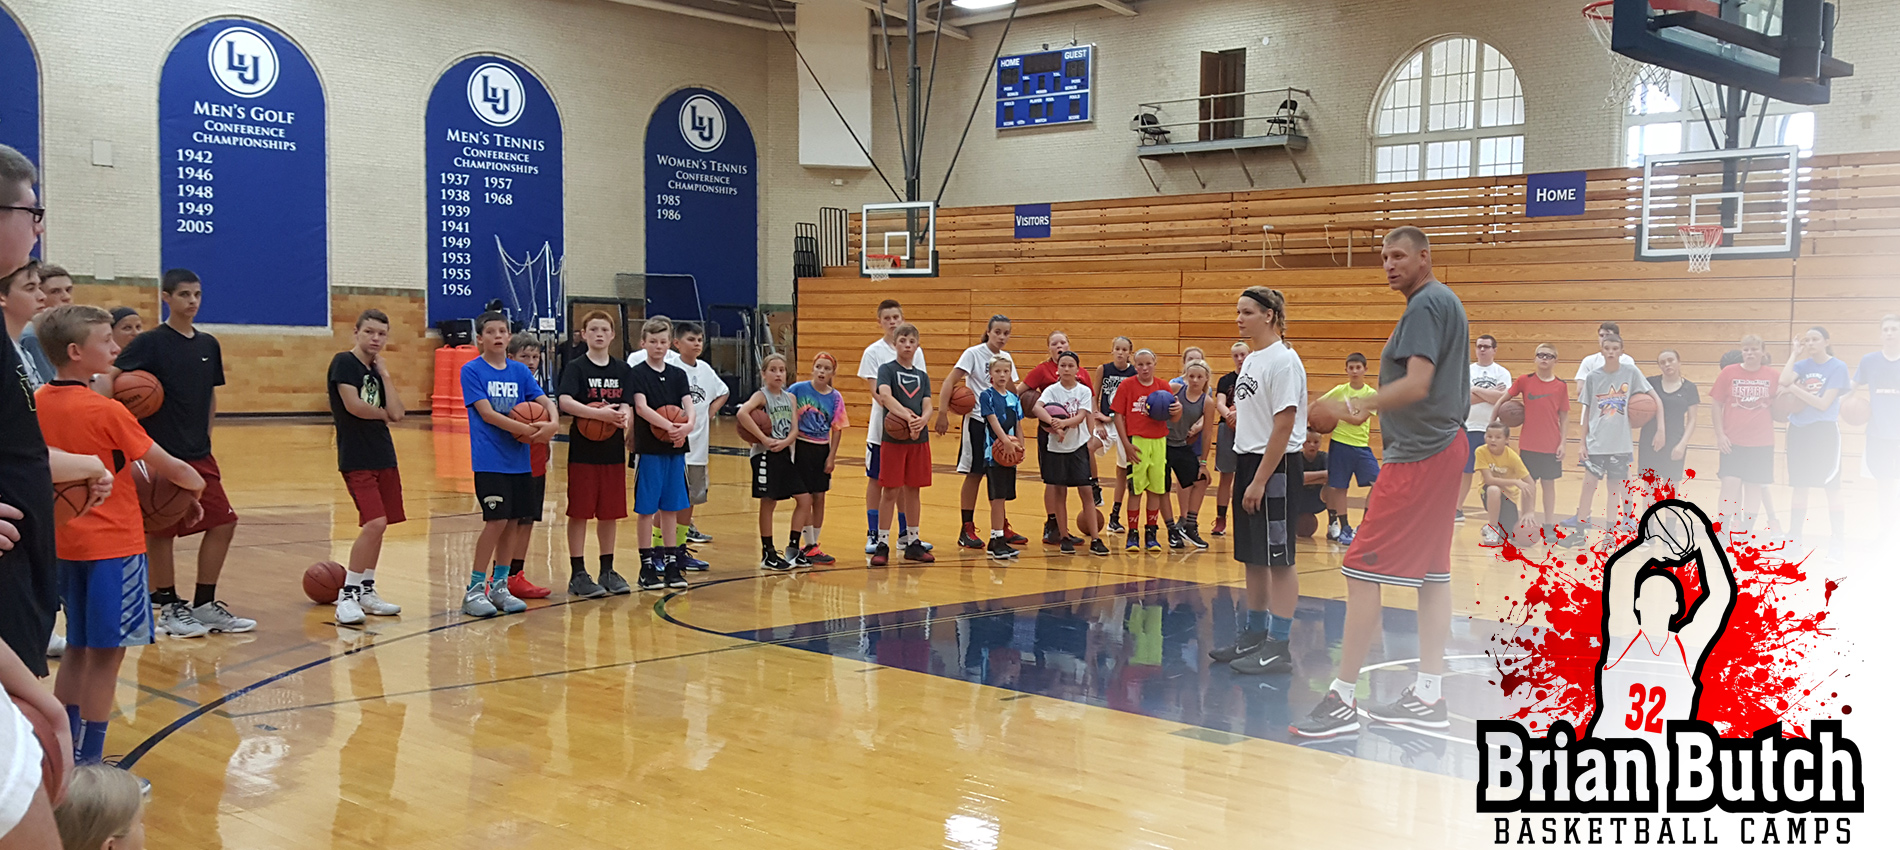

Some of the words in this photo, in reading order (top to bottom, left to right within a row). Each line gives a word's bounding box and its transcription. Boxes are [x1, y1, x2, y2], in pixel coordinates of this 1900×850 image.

[1064, 50, 1087, 60] GUEST
[1000, 58, 1020, 67] HOME
[193, 101, 246, 119] MEN'S
[250, 107, 295, 124] GOLF
[203, 120, 285, 138] CONFERENCE
[192, 132, 296, 151] CHAMPIONSHIPS
[446, 129, 490, 147] MEN'S
[493, 134, 545, 151] TENNIS
[177, 149, 213, 164] 1942
[462, 147, 530, 163] CONFERENCE
[453, 157, 539, 175] CHAMPIONSHIPS
[656, 154, 707, 170] WOMEN'S
[709, 160, 748, 175] TENNIS
[177, 166, 214, 181] 1946
[440, 173, 470, 186] 1937
[675, 170, 731, 184] CONFERENCE
[484, 177, 513, 190] 1957
[668, 180, 738, 195] CHAMPIONSHIPS
[177, 184, 213, 199] 1948
[440, 189, 470, 202] 1938
[1536, 188, 1576, 202] HOME
[484, 193, 513, 206] 1968
[656, 194, 681, 206] 1985
[177, 202, 214, 216] 1949
[441, 205, 471, 218] 1939
[656, 208, 681, 221] 1986
[176, 219, 214, 234] 2005
[1016, 215, 1049, 226] VISITORS
[441, 221, 470, 234] 1941
[441, 237, 471, 249] 1949
[442, 253, 471, 265] 1953
[441, 269, 471, 281] 1955
[441, 285, 472, 297] 1956
[487, 381, 519, 398] NEVER
[588, 378, 602, 388] WE
[603, 378, 619, 388] ARE
